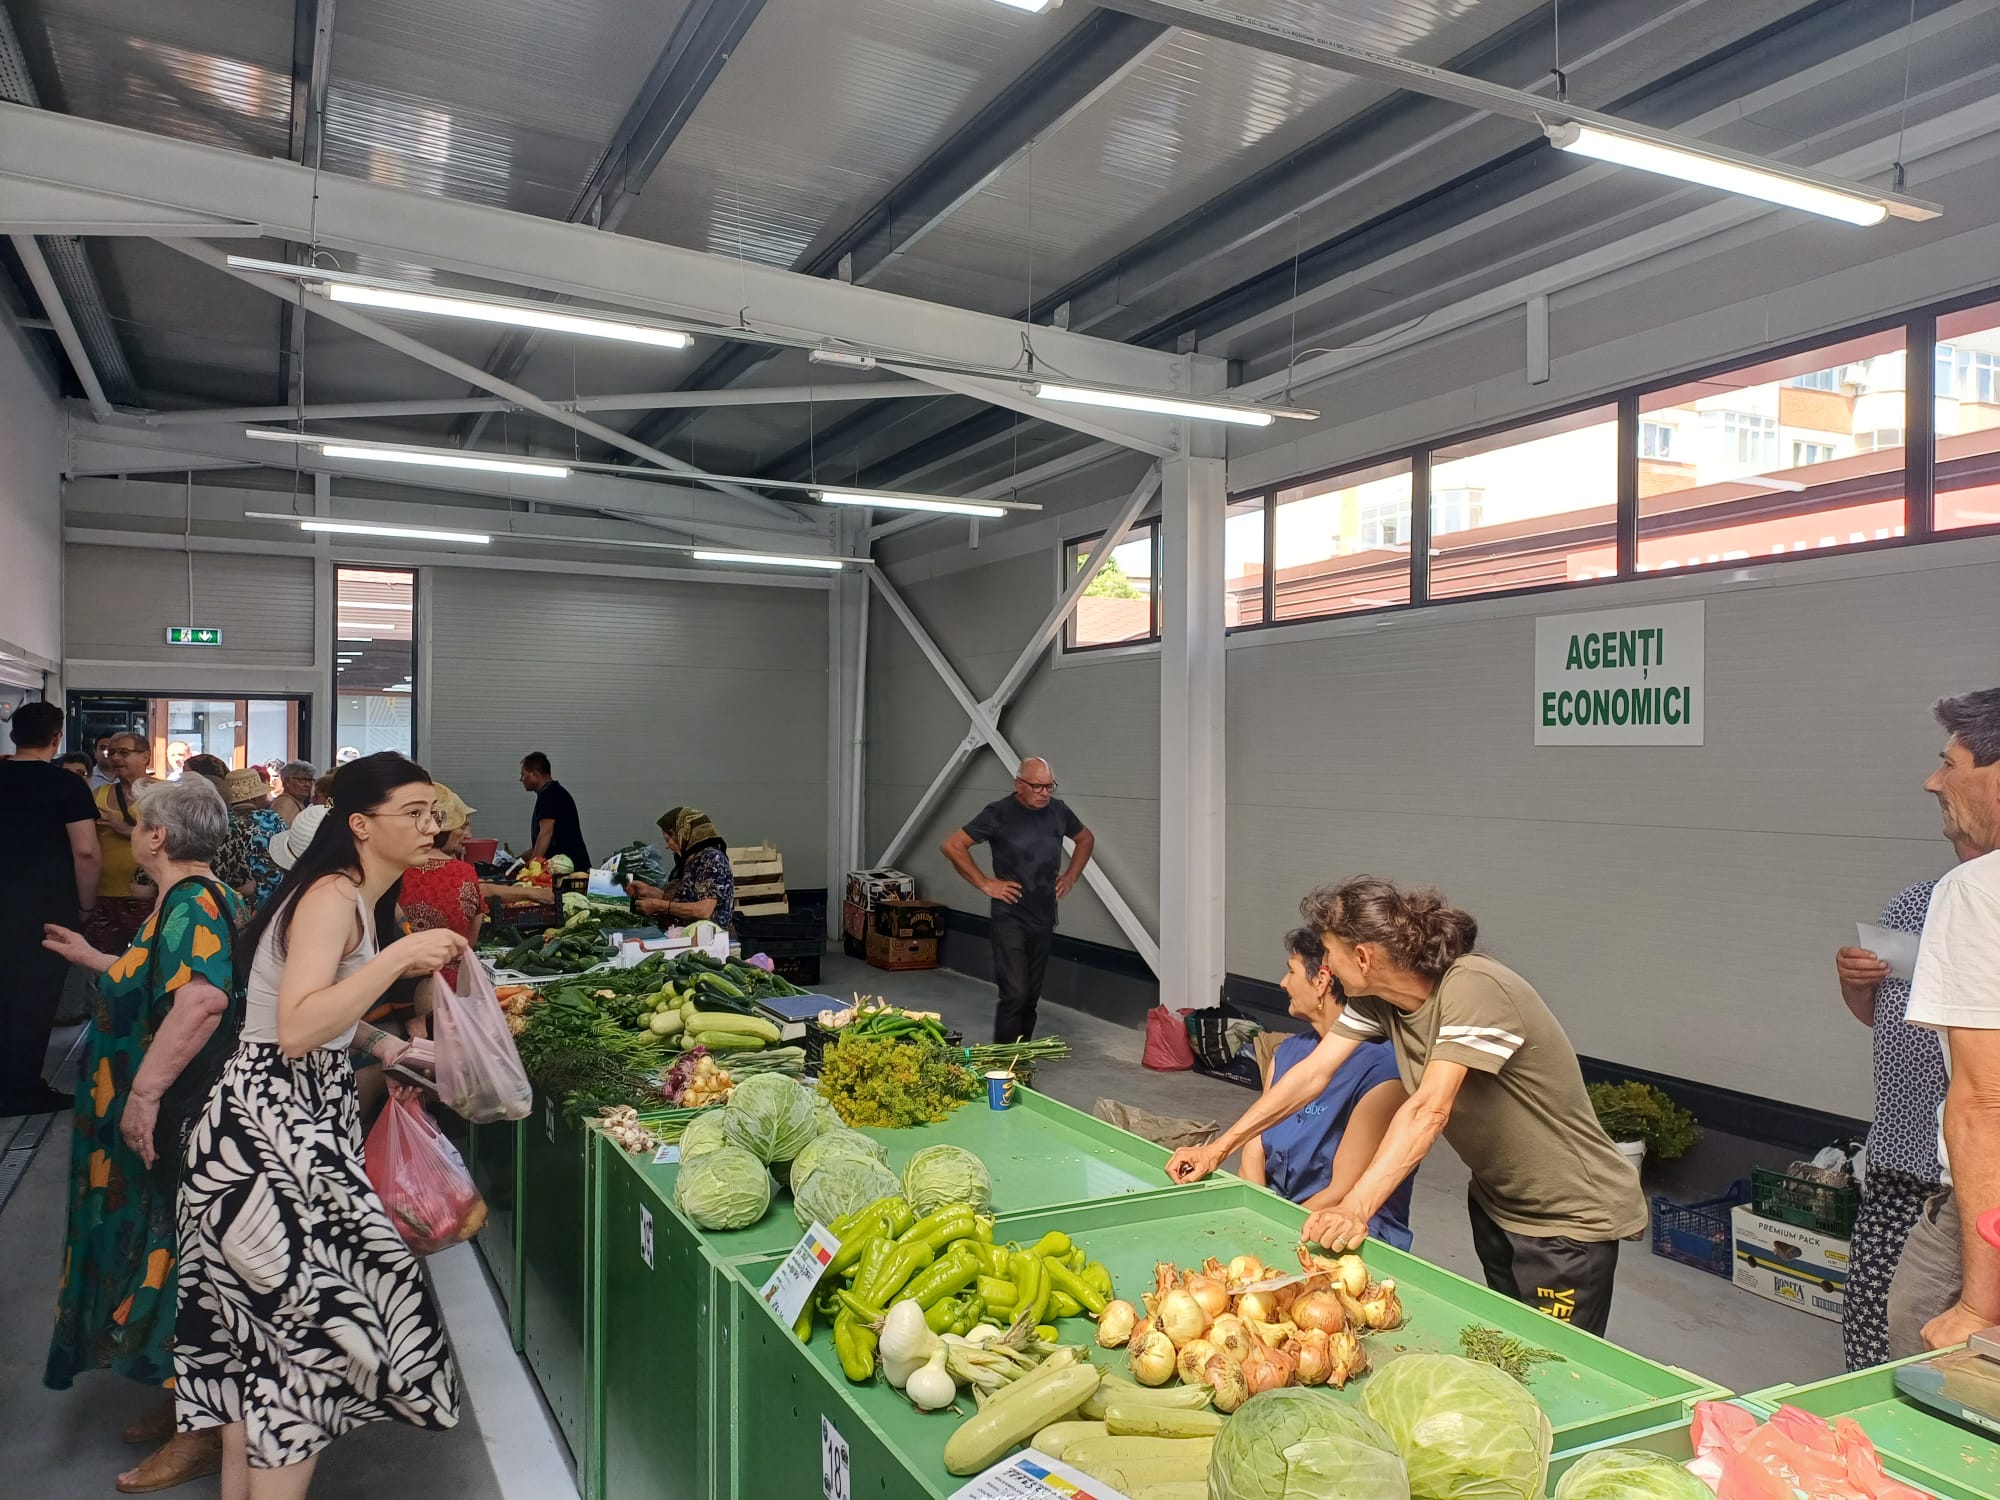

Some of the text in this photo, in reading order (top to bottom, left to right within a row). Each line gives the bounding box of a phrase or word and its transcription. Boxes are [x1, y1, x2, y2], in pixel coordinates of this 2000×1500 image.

[1565, 628, 1663, 680] AGENȚI
[1542, 686, 1690, 727] ECONOMICI
[1758, 1222, 1796, 1240] PREMIUM
[1799, 1234, 1820, 1247] PACK
[1554, 1288, 1576, 1322] VE
[828, 1439, 842, 1499] 18
